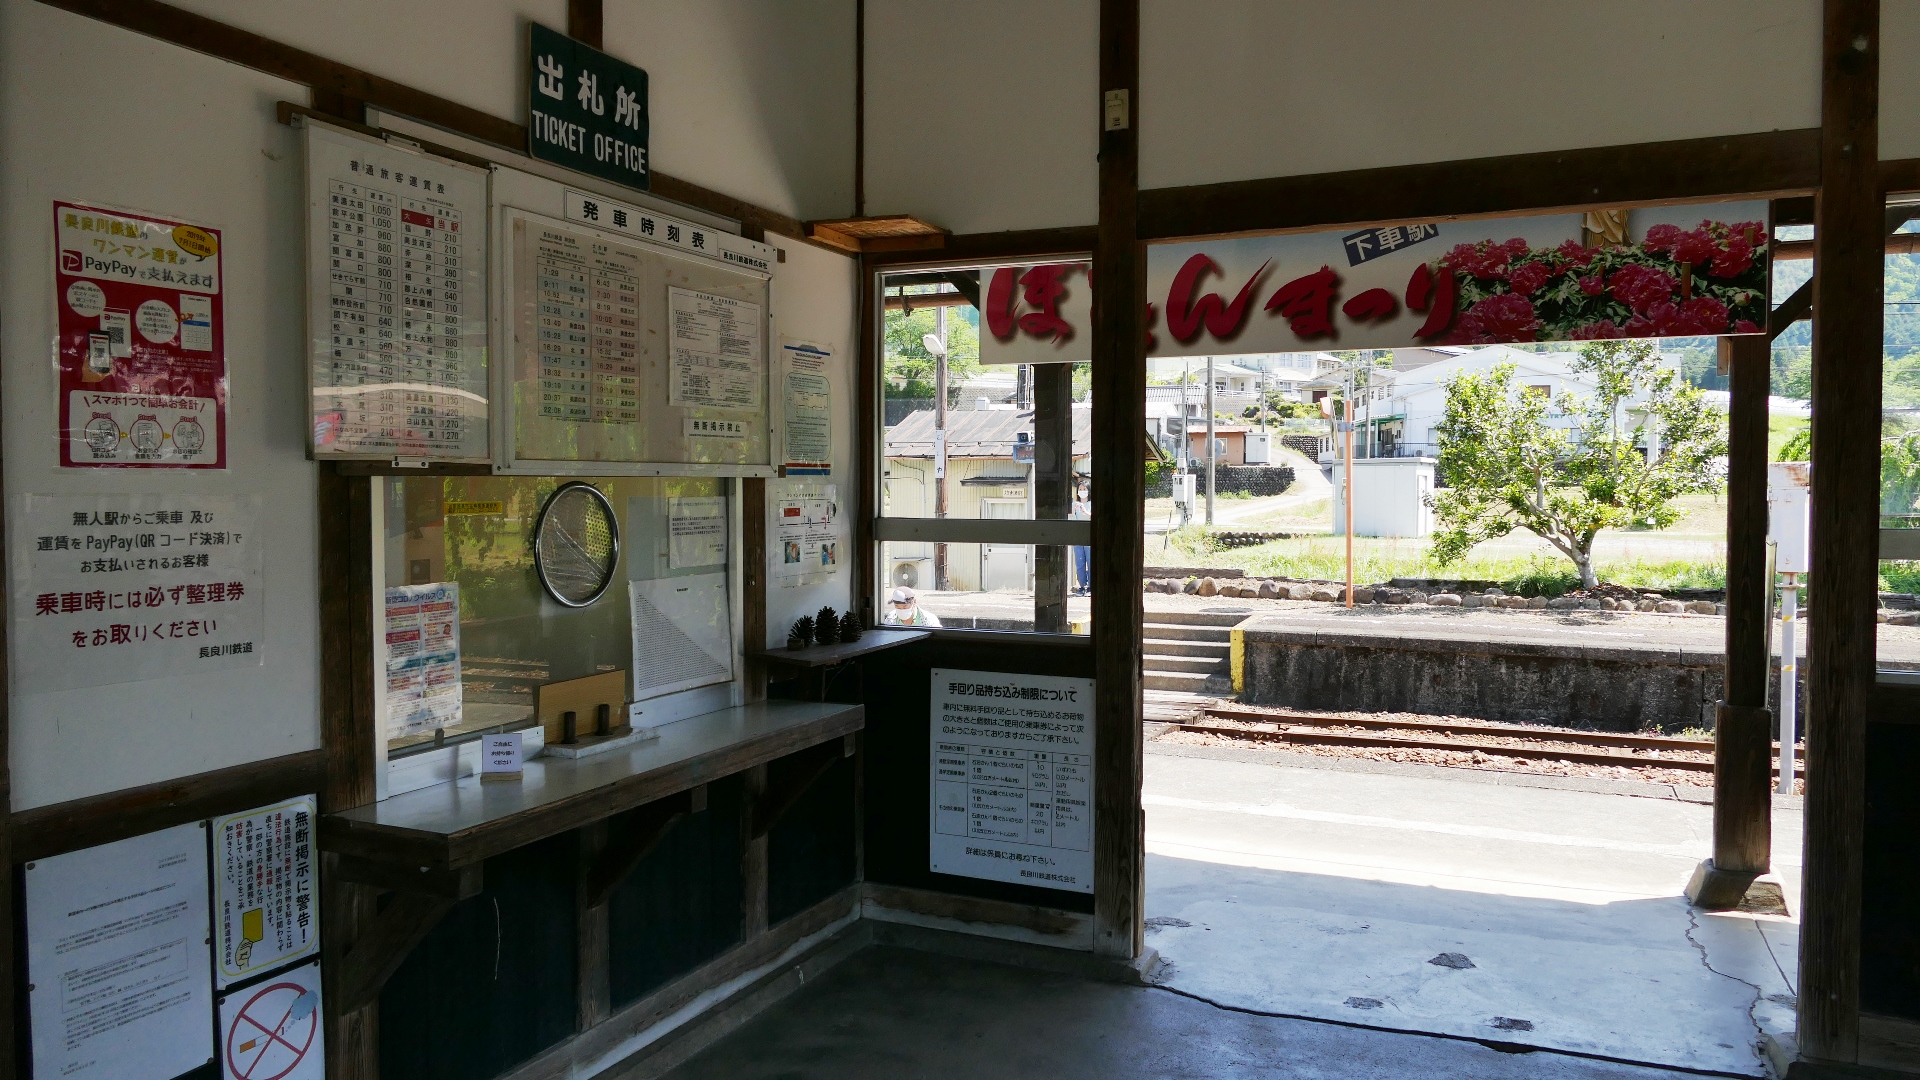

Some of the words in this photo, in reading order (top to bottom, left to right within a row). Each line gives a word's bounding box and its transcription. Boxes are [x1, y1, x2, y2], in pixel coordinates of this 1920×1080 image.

[538, 54, 641, 130] 出札所
[532, 109, 586, 155] TICKET
[594, 133, 646, 174] OFFICE
[350, 160, 445, 195] 普通旅客運賃表
[372, 205, 391, 216] 1,050
[372, 217, 391, 228] 1,050
[583, 200, 705, 250] 発車時刻表
[377, 231, 391, 241] 960
[444, 234, 456, 243] 210
[444, 245, 456, 255] 210
[377, 255, 391, 265] 800
[444, 257, 457, 266] 310
[377, 268, 391, 278] 800
[444, 268, 457, 278] 390
[544, 267, 559, 277] 7:29
[378, 280, 391, 290] 710
[444, 280, 457, 290] 470
[544, 281, 559, 289] 9:11
[379, 292, 391, 303] 710
[444, 292, 457, 301] 640
[986, 253, 1459, 344] ぼんまつり
[379, 304, 392, 315] 710
[445, 303, 457, 313] 710
[379, 316, 392, 327] 640
[595, 315, 612, 323] 10:02
[379, 328, 392, 338] 640
[595, 326, 612, 335] 11:40
[445, 338, 458, 348] 880
[543, 356, 561, 364] 17:47
[379, 366, 392, 376] 470
[543, 368, 561, 377] 18:32
[543, 393, 561, 402] 20:37
[693, 421, 741, 432] 無断掲示禁止
[72, 510, 183, 526] 無人駅からご乗車
[190, 511, 213, 524] 及び
[37, 536, 82, 552] 運賃を
[87, 533, 156, 552] PayPay(QR
[80, 554, 210, 573] お支払いされるお客様
[35, 581, 245, 616] 乗車時には必ず整理券
[72, 620, 218, 649] をお取りください
[199, 642, 253, 658] 長良川鉄道
[949, 683, 1077, 702] 手回り品持ち込み制限について
[943, 703, 1084, 721] 車内に無料手回り品として持ち込めるお荷物
[943, 714, 1084, 733] の大きさと個数はご使用の乗車券によって次
[943, 726, 1079, 745] のようになっておりますからご了承下さい。
[1020, 870, 1076, 884] 長良川鉄道株式会社
